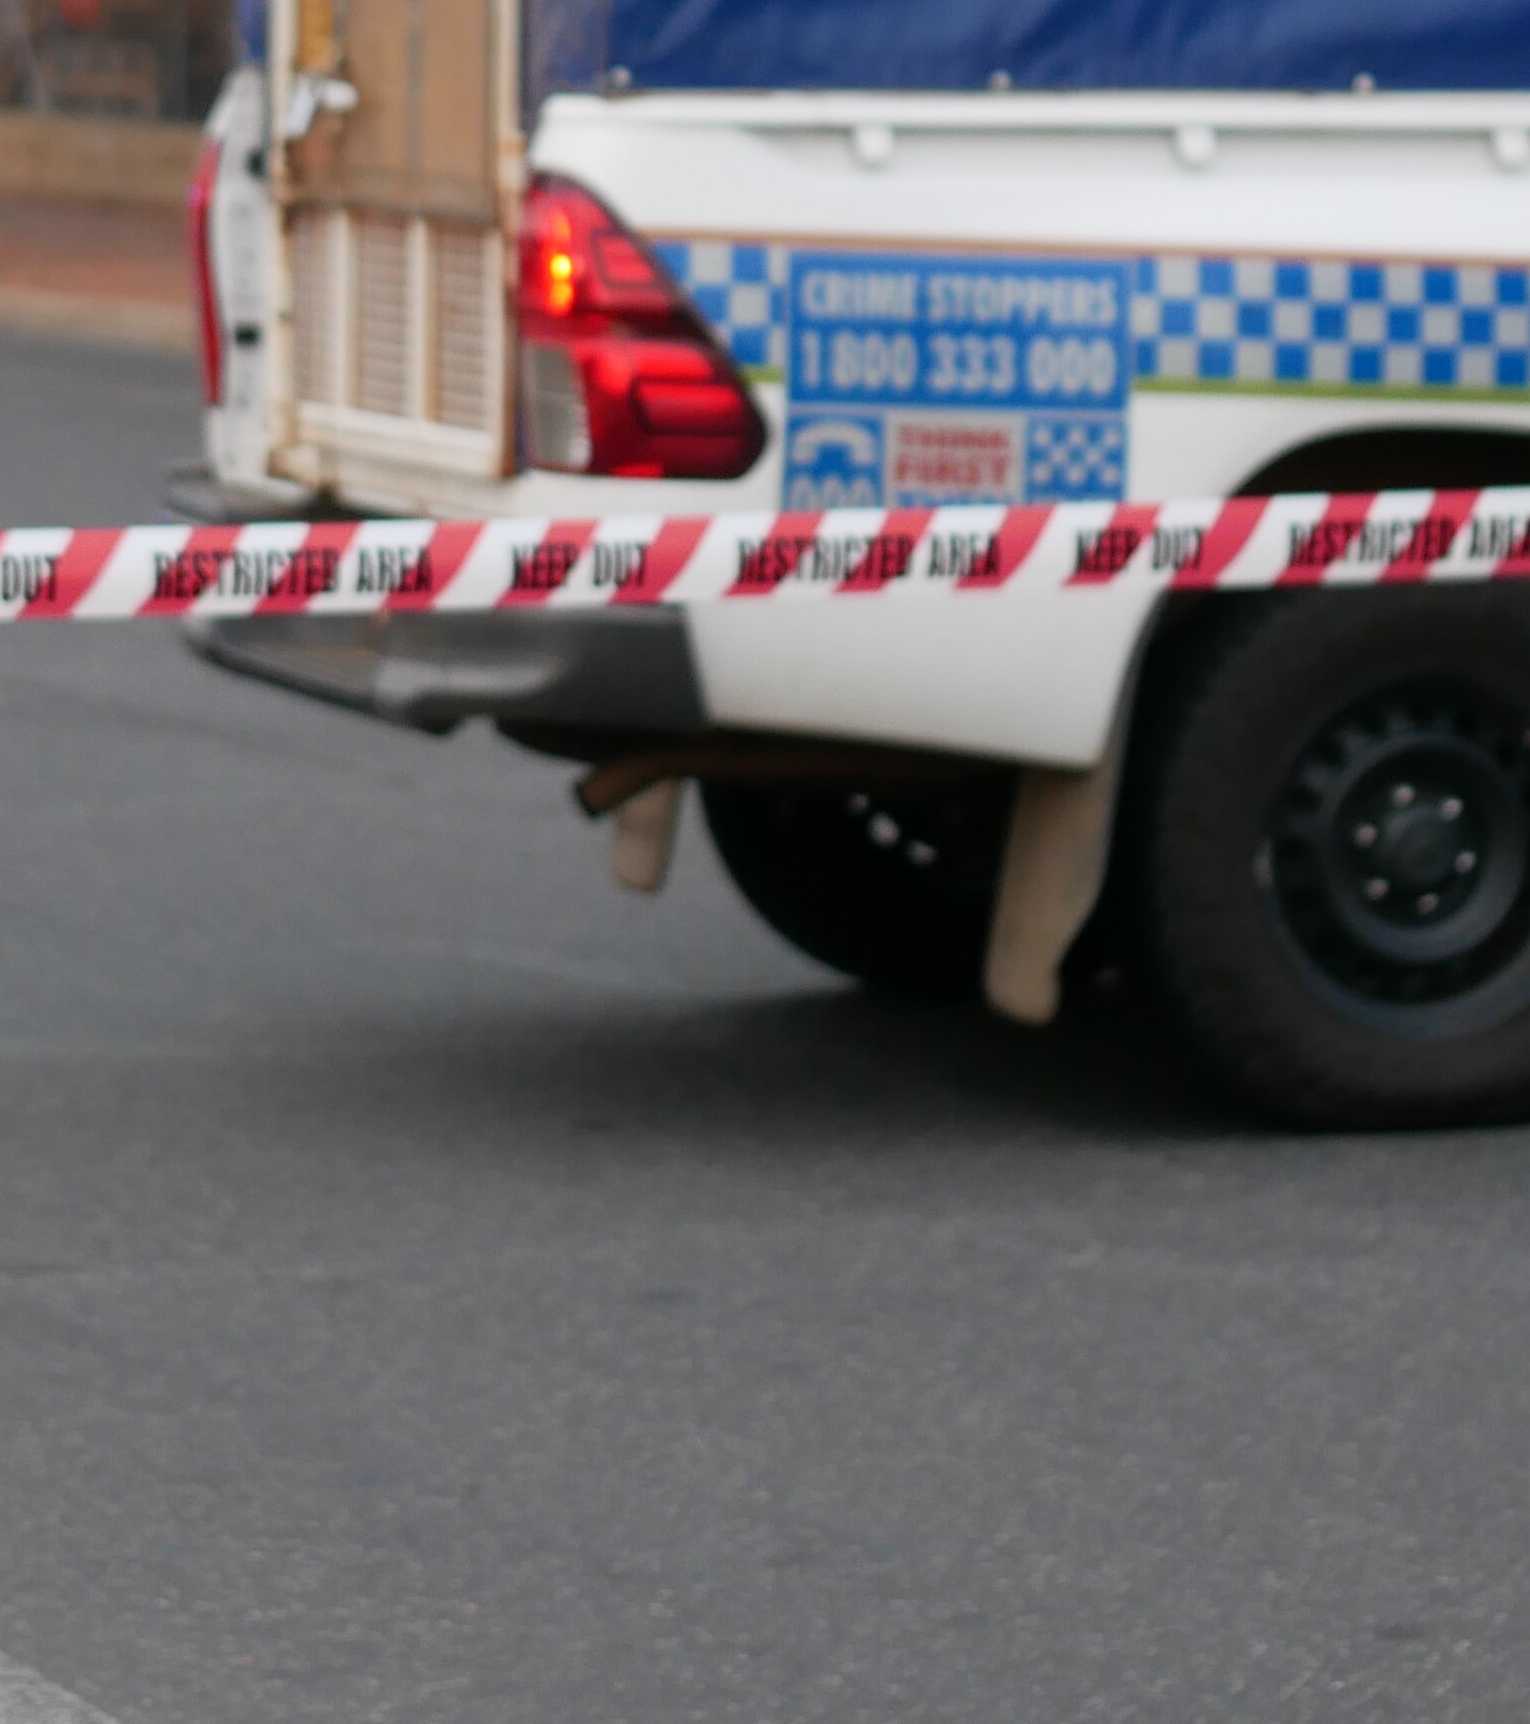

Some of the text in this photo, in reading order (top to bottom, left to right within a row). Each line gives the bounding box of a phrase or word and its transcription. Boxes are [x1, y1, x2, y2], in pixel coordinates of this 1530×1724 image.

[802, 271, 1117, 326] CRIME STOPPERS
[801, 333, 1117, 396] 1 800 333 000
[2, 555, 61, 602] OUT
[153, 548, 339, 600] RESTRICTED
[357, 546, 432, 592] AREA
[511, 542, 575, 591] KEEP
[593, 541, 650, 588] OUT
[737, 534, 913, 586] RESTRICTED
[927, 531, 1001, 577] AREA
[1073, 526, 1139, 573] KEEP
[1153, 526, 1204, 572] OUT
[1289, 519, 1454, 566] RESTRICTED
